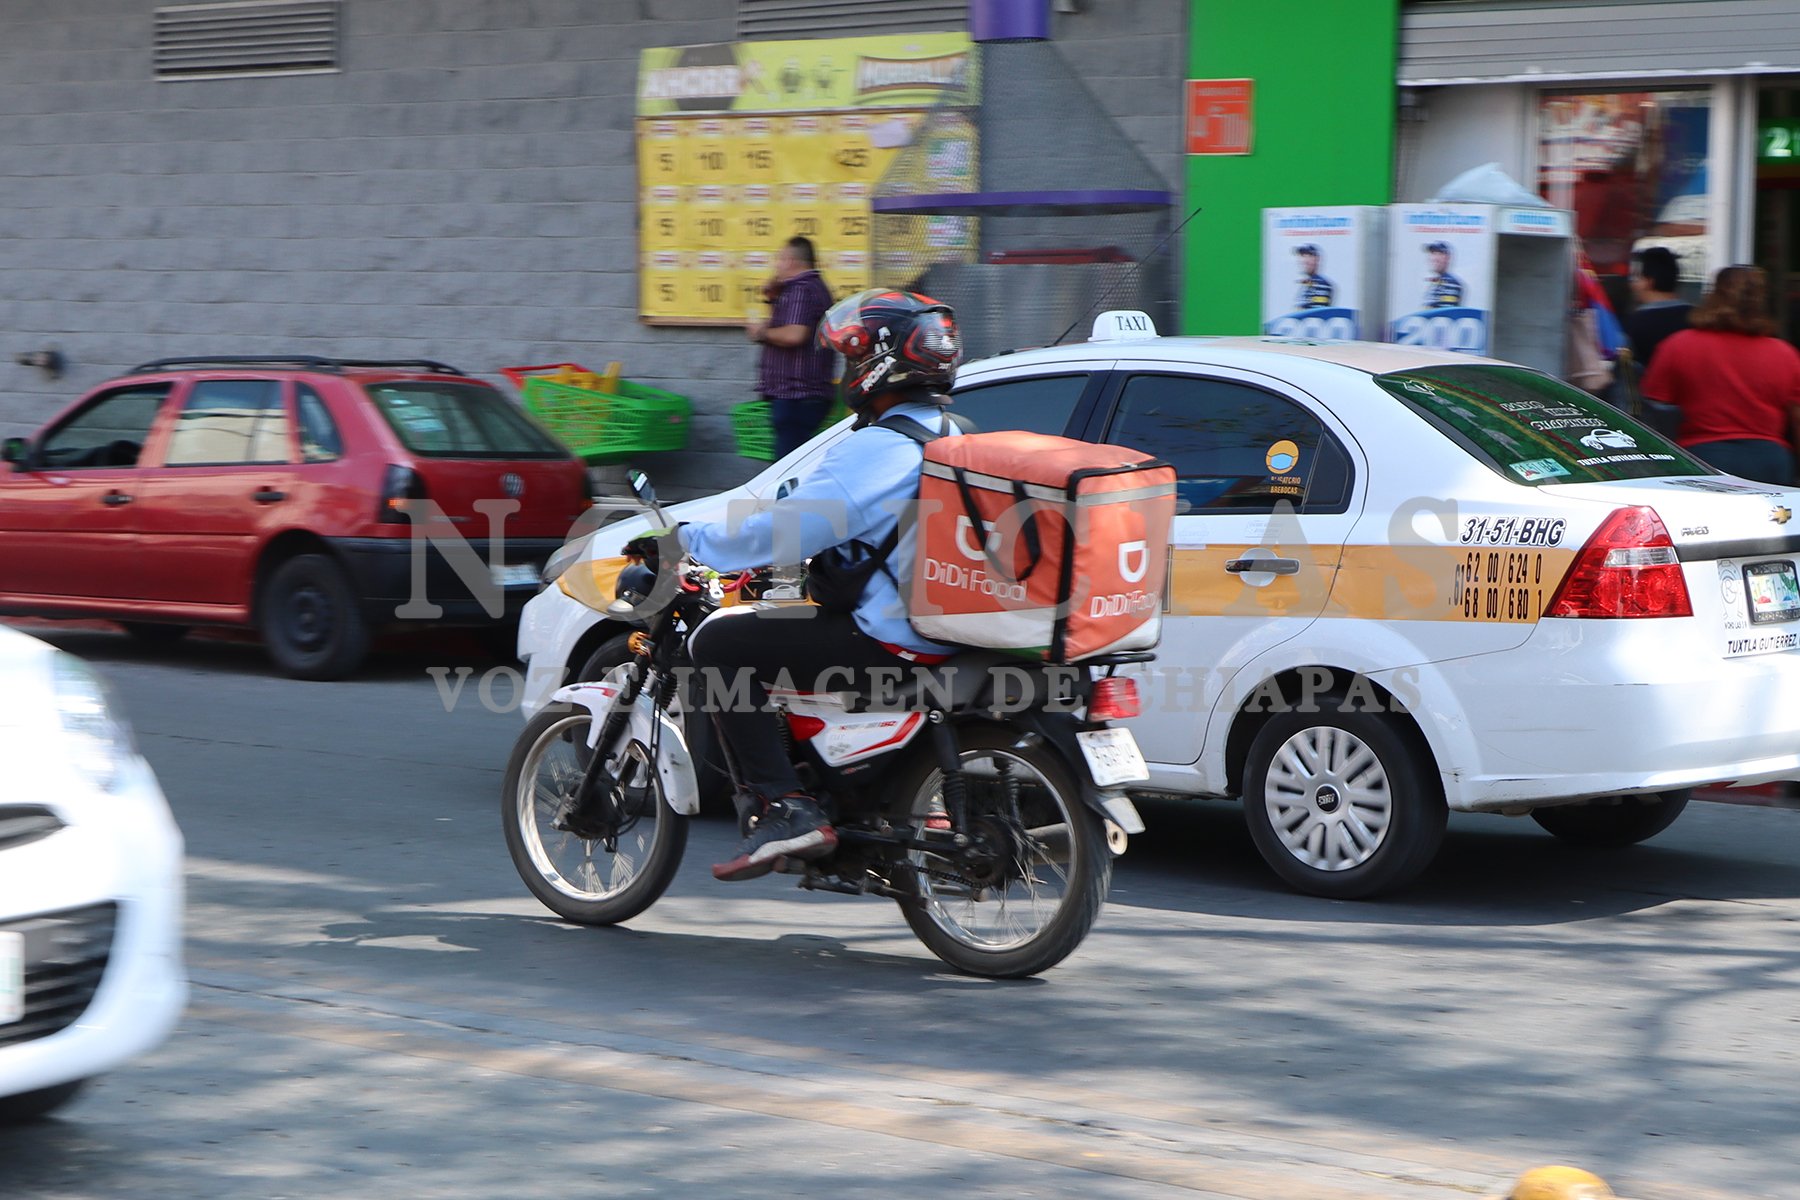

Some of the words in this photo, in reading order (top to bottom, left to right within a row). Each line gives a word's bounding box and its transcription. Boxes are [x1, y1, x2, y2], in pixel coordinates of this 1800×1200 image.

[1114, 315, 1148, 331] TAXI
[1398, 315, 1480, 349] 200
[1460, 516, 1566, 548] 31-51-BHG
[1727, 638, 1757, 654] TUXTLA
